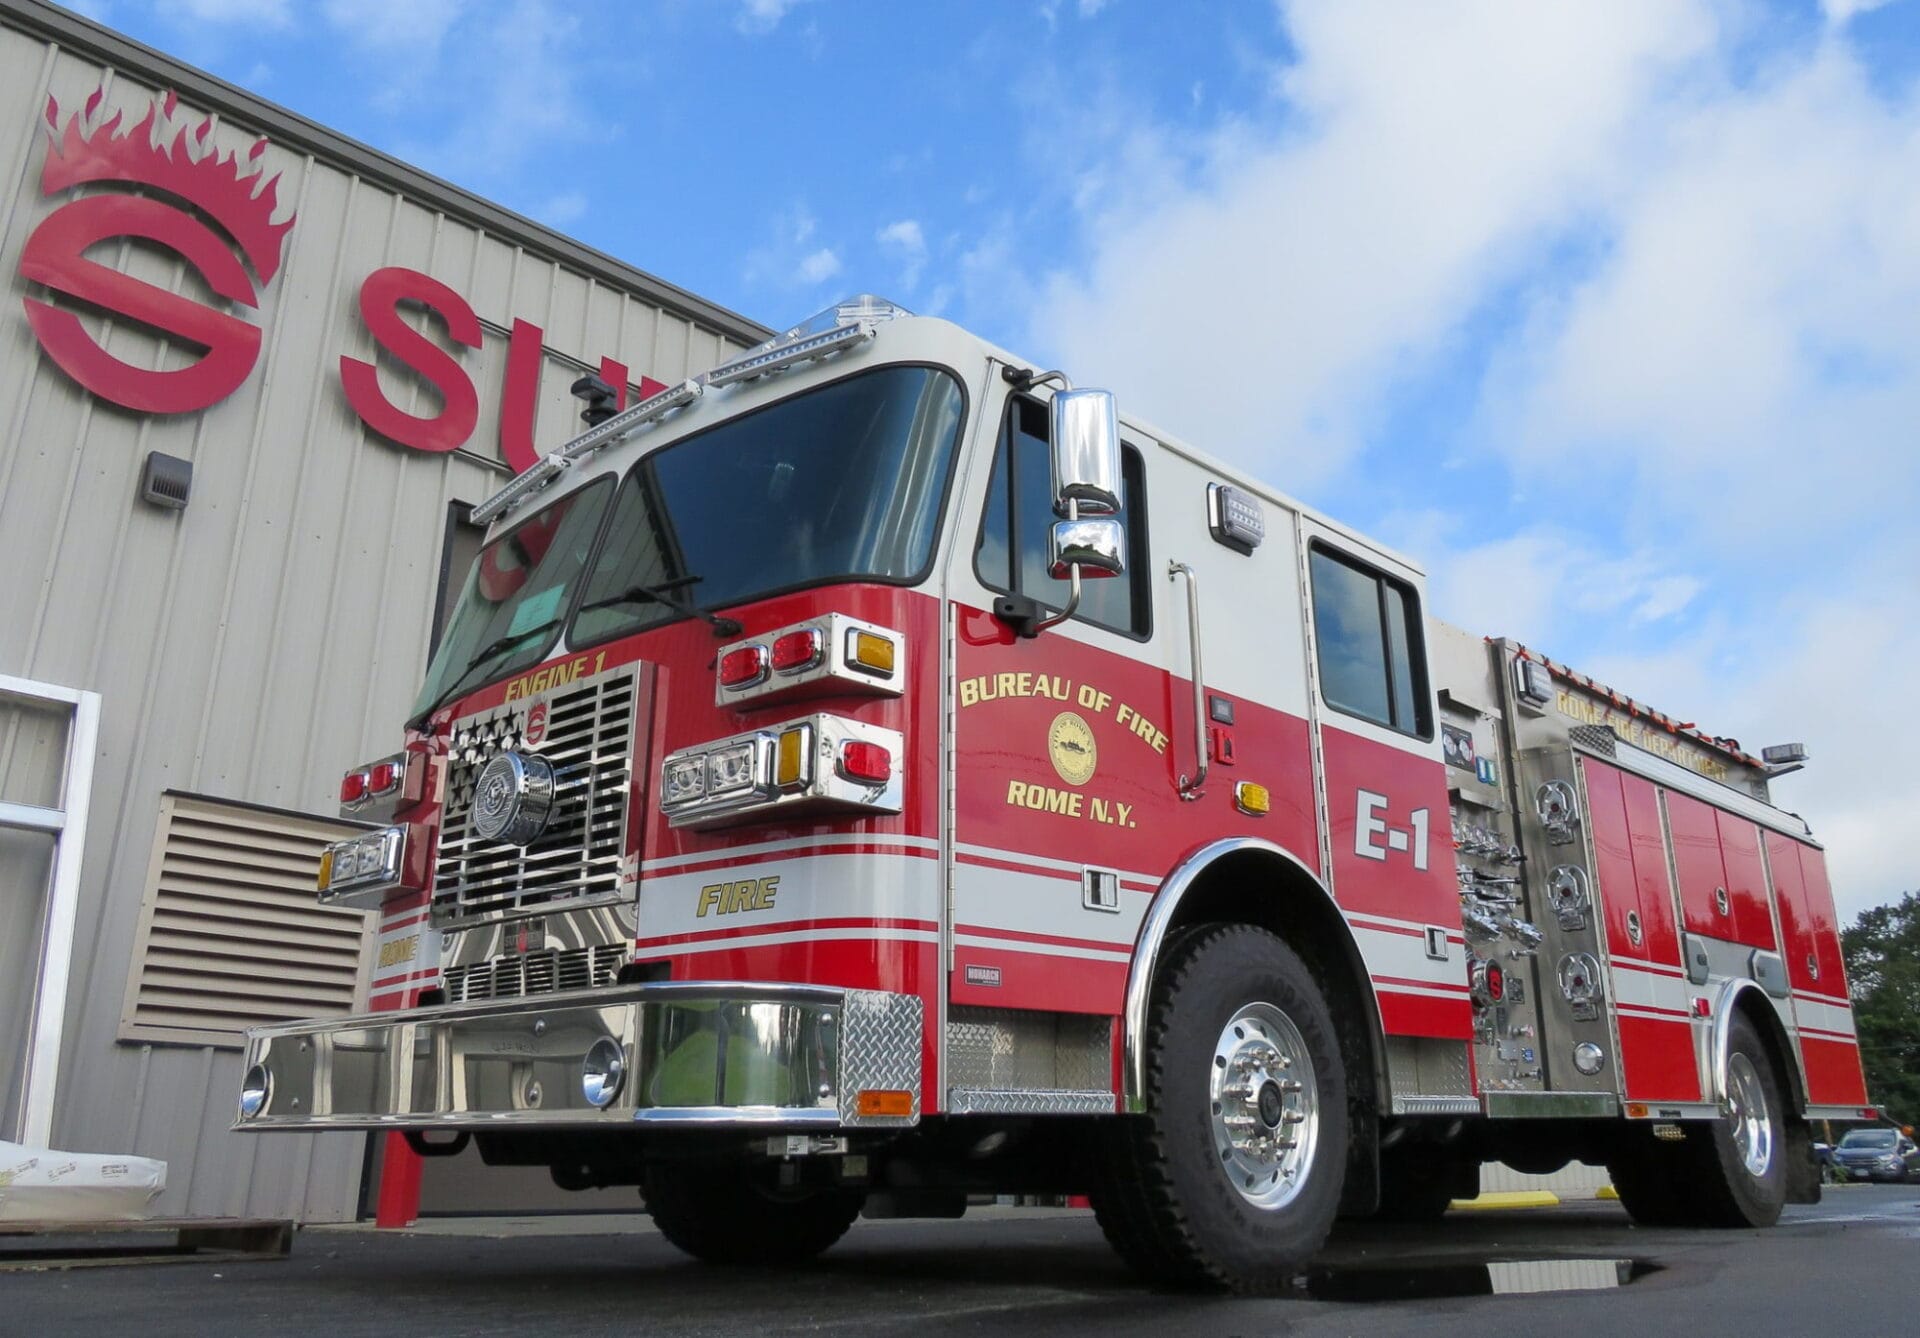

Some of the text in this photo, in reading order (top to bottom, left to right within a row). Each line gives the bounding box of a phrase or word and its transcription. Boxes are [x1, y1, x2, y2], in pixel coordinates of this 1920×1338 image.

[504, 651, 606, 704] ENGINE 1
[959, 672, 1169, 755] BUREAU OF FIRE
[1556, 690, 1601, 726] ROME
[1606, 715, 1640, 744] FIRE
[1007, 779, 1136, 828] ROME N.Y.
[1355, 787, 1429, 872] E-1
[696, 875, 780, 917] FIRE
[378, 934, 419, 969] ROME
